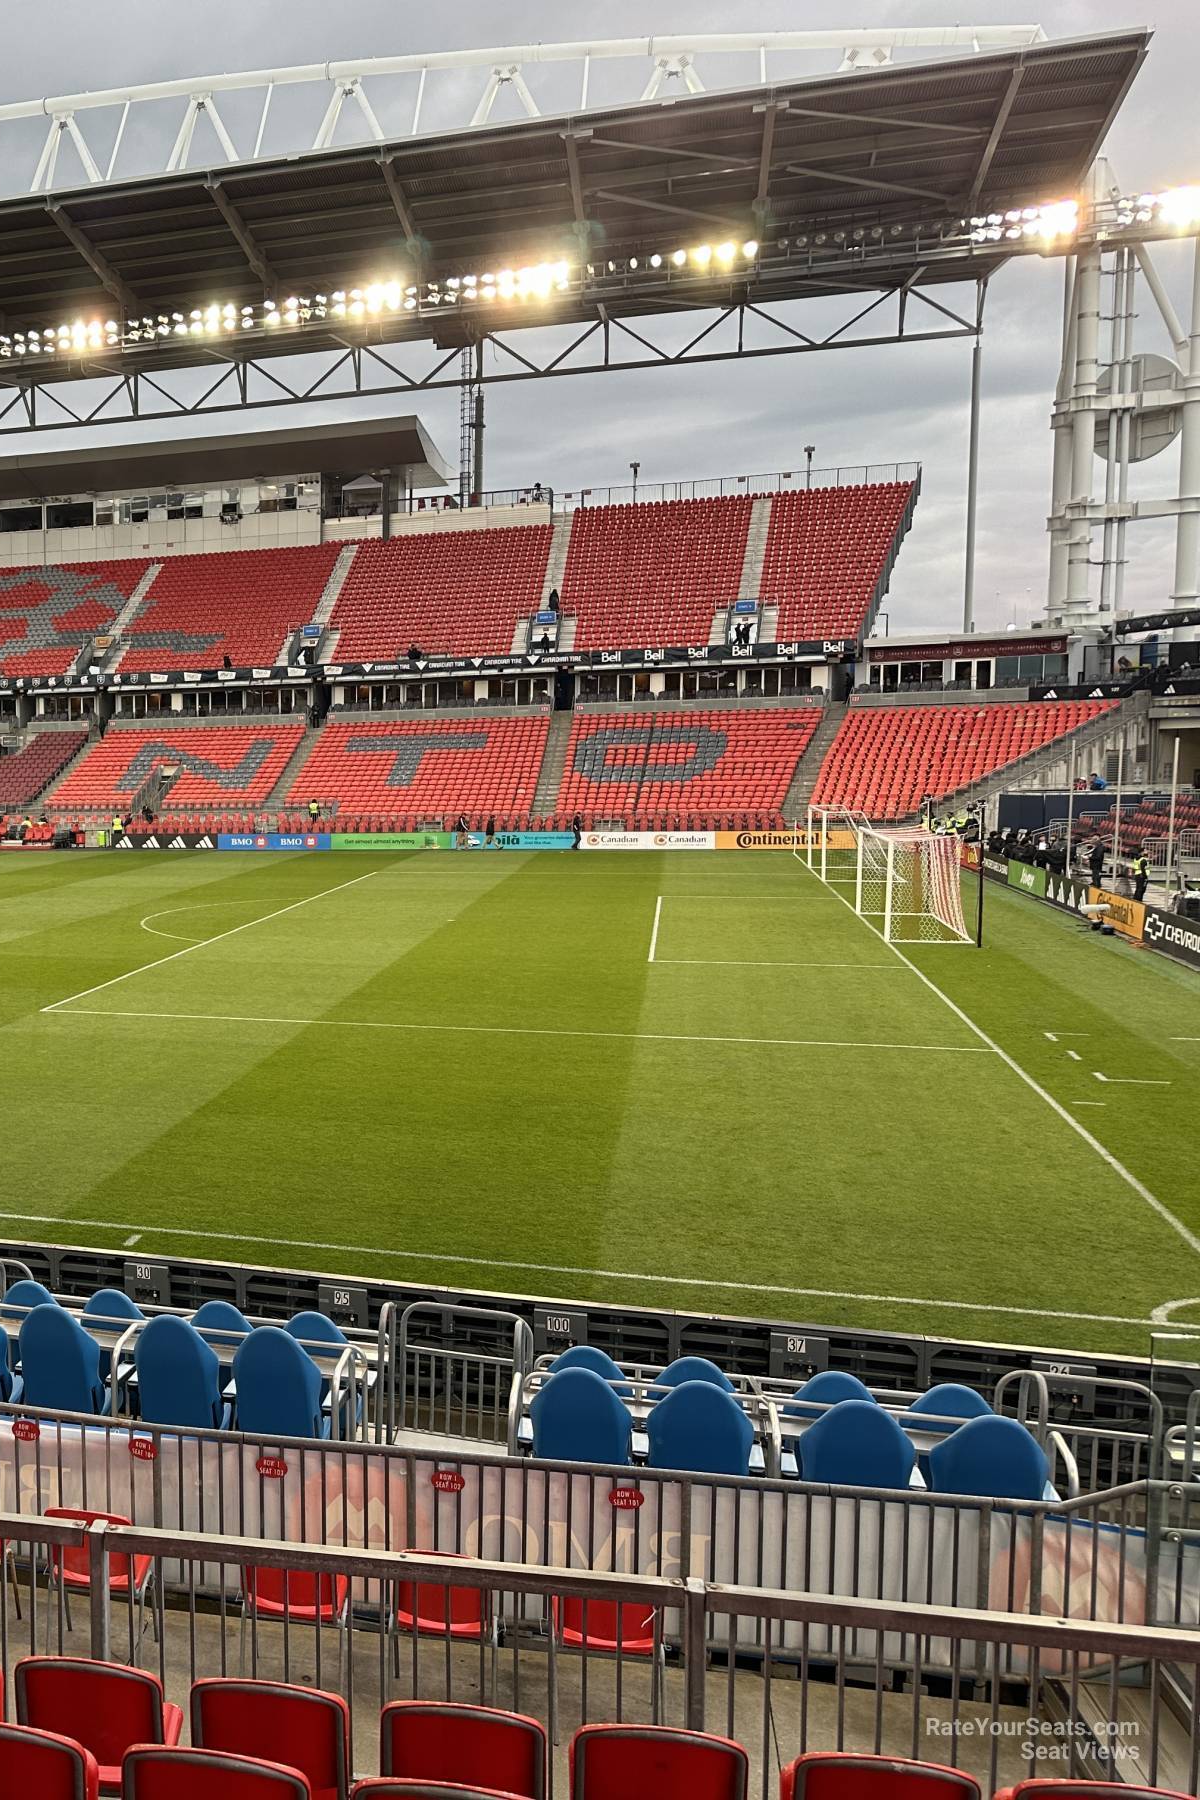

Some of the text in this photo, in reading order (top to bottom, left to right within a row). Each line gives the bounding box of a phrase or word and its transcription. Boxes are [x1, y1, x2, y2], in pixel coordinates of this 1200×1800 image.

[732, 645, 752, 657] Bell
[777, 643, 798, 655] Bell
[823, 641, 845, 653] Bell
[601, 651, 621, 662] Bell
[644, 649, 664, 661] Bell
[688, 647, 708, 659] Bell
[231, 838, 253, 846] BMO
[280, 838, 302, 846] BMO
[601, 835, 638, 843] Canadian
[668, 835, 706, 843] Canadian
[137, 1265, 150, 1279] 30
[335, 1291, 349, 1305] 95
[547, 1317, 570, 1332] 100
[788, 1338, 806, 1353] 37
[135, 1441, 146, 1449] ROW
[132, 1447, 143, 1456] SEAT
[439, 1473, 452, 1481] ROW
[435, 1481, 449, 1489] SEAT
[616, 1490, 629, 1498] ROW
[613, 1498, 628, 1506] SEAT
